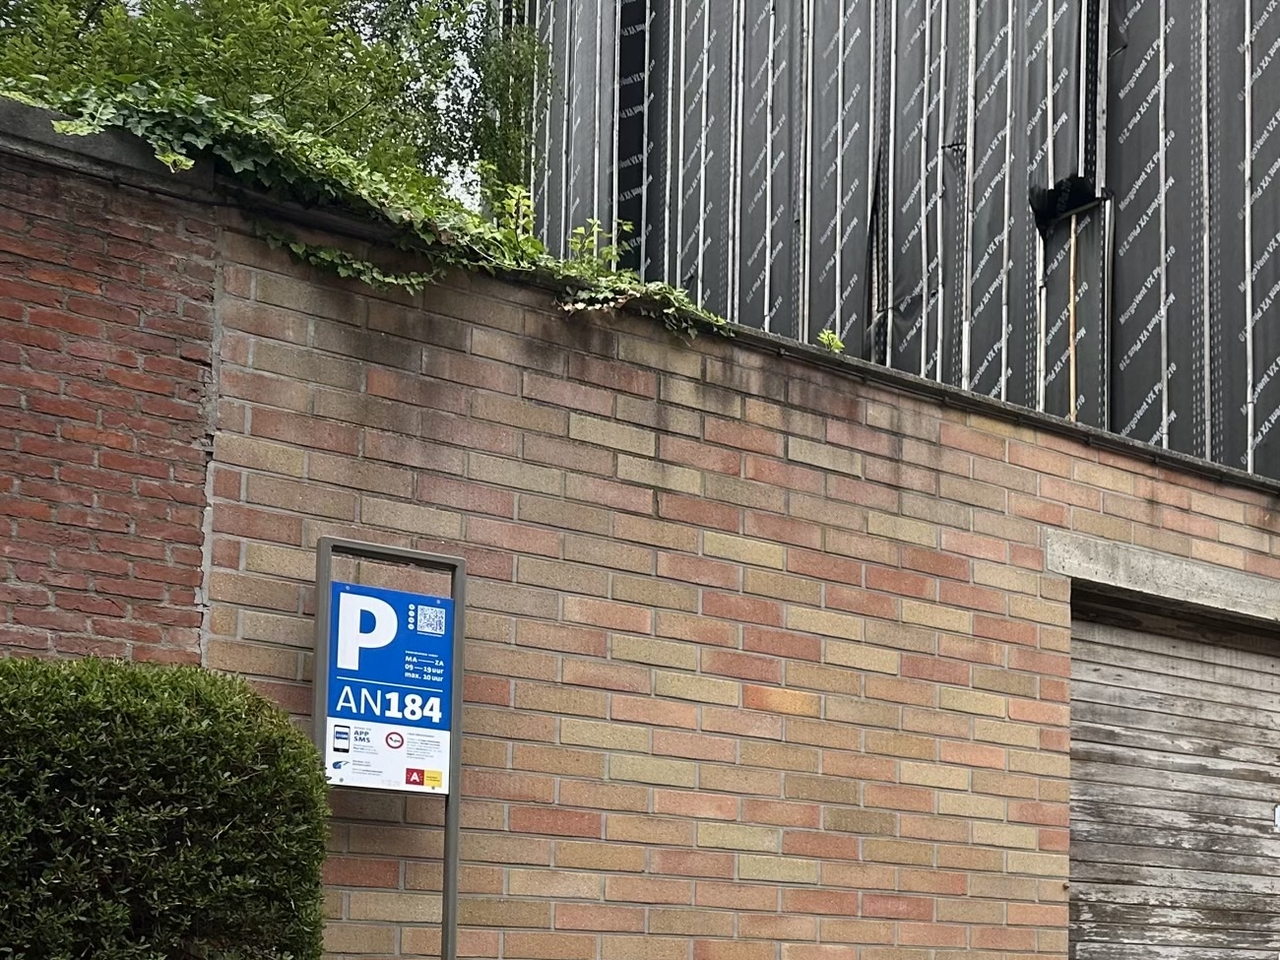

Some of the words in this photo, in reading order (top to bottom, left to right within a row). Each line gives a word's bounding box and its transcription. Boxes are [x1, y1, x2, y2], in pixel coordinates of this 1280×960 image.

[1127, 1, 1141, 19] Plus
[1118, 18, 1130, 34] 210
[1237, 11, 1270, 54] MgoVent
[1144, 47, 1155, 60] VX
[1165, 16, 1176, 34] 210
[1260, 56, 1271, 70] VX
[1138, 101, 1150, 115] VX
[1127, 111, 1141, 130] Plus
[1118, 128, 1130, 144] 210
[1238, 130, 1269, 172] MgoVent
[1266, 117, 1278, 132] VX
[1144, 160, 1156, 174] VX
[1165, 130, 1176, 147] 210
[1260, 176, 1272, 190] VX
[1138, 214, 1150, 228] VX
[1128, 224, 1140, 242] Plus
[1118, 240, 1130, 256] 210
[1144, 274, 1156, 288] VX
[1166, 246, 1176, 262] 210
[1238, 251, 1270, 293] MgoVent
[1266, 238, 1278, 253] VX
[1260, 298, 1272, 312] VX
[1139, 330, 1150, 344] VX
[1128, 339, 1142, 358] Plus
[1118, 355, 1130, 371] 210
[1146, 390, 1156, 404] VX
[1167, 362, 1177, 379] 210
[1240, 374, 1270, 416] MgoVent
[1267, 362, 1279, 376] VX
[1260, 421, 1272, 436] VX
[337, 592, 398, 670] P
[336, 686, 442, 723] AN184
[410, 772, 420, 782] A
